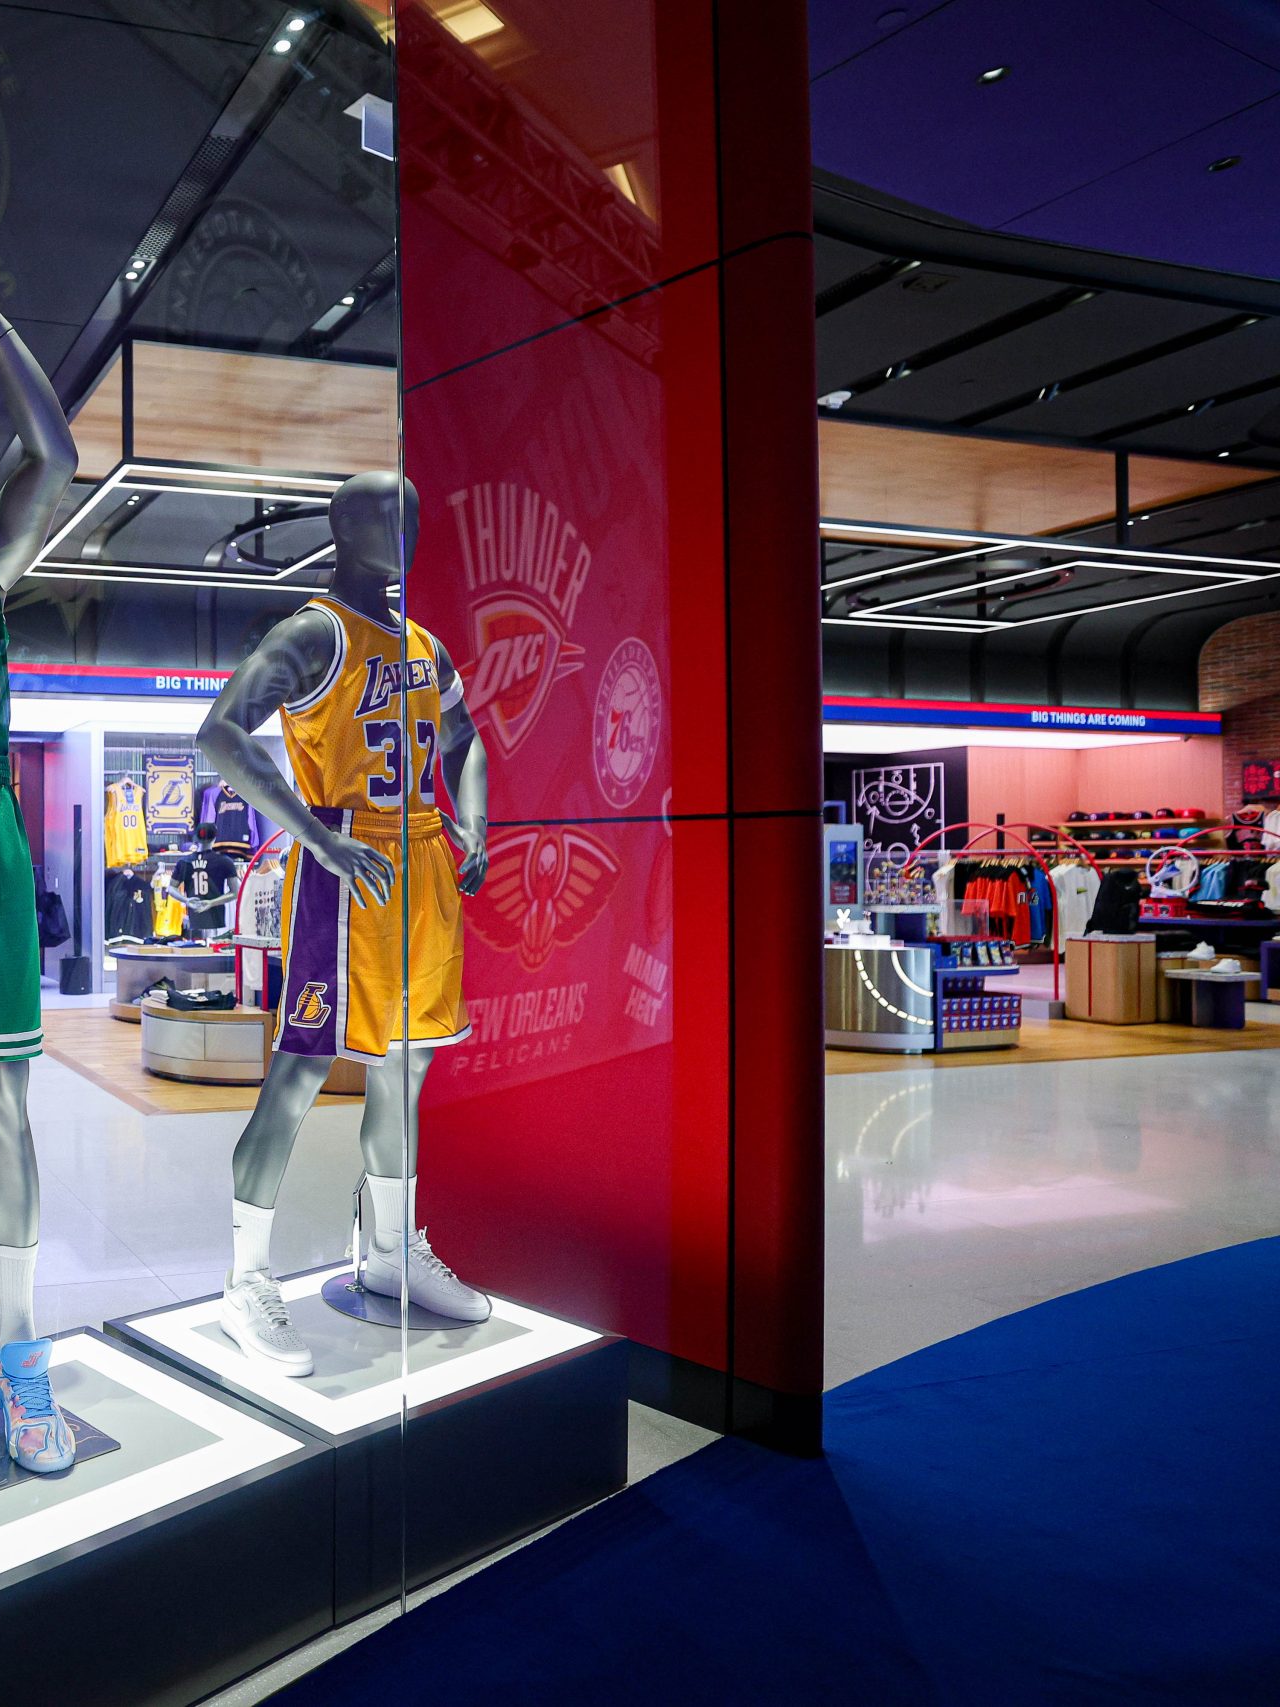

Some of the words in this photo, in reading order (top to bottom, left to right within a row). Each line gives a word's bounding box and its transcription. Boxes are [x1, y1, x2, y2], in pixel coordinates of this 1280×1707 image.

[446, 482, 591, 628] THUNDER
[156, 676, 181, 690] BIG
[470, 632, 546, 711] OKC
[1031, 711, 1048, 723] BIG
[1049, 711, 1086, 725] THINGS
[1087, 713, 1107, 726] ARE
[1107, 714, 1146, 727] COMING
[363, 719, 438, 807] 32
[123, 814, 137, 828] 00
[191, 871, 209, 895] 16
[507, 982, 588, 1038] ORLEANS
[453, 1034, 572, 1076] PELICANS
